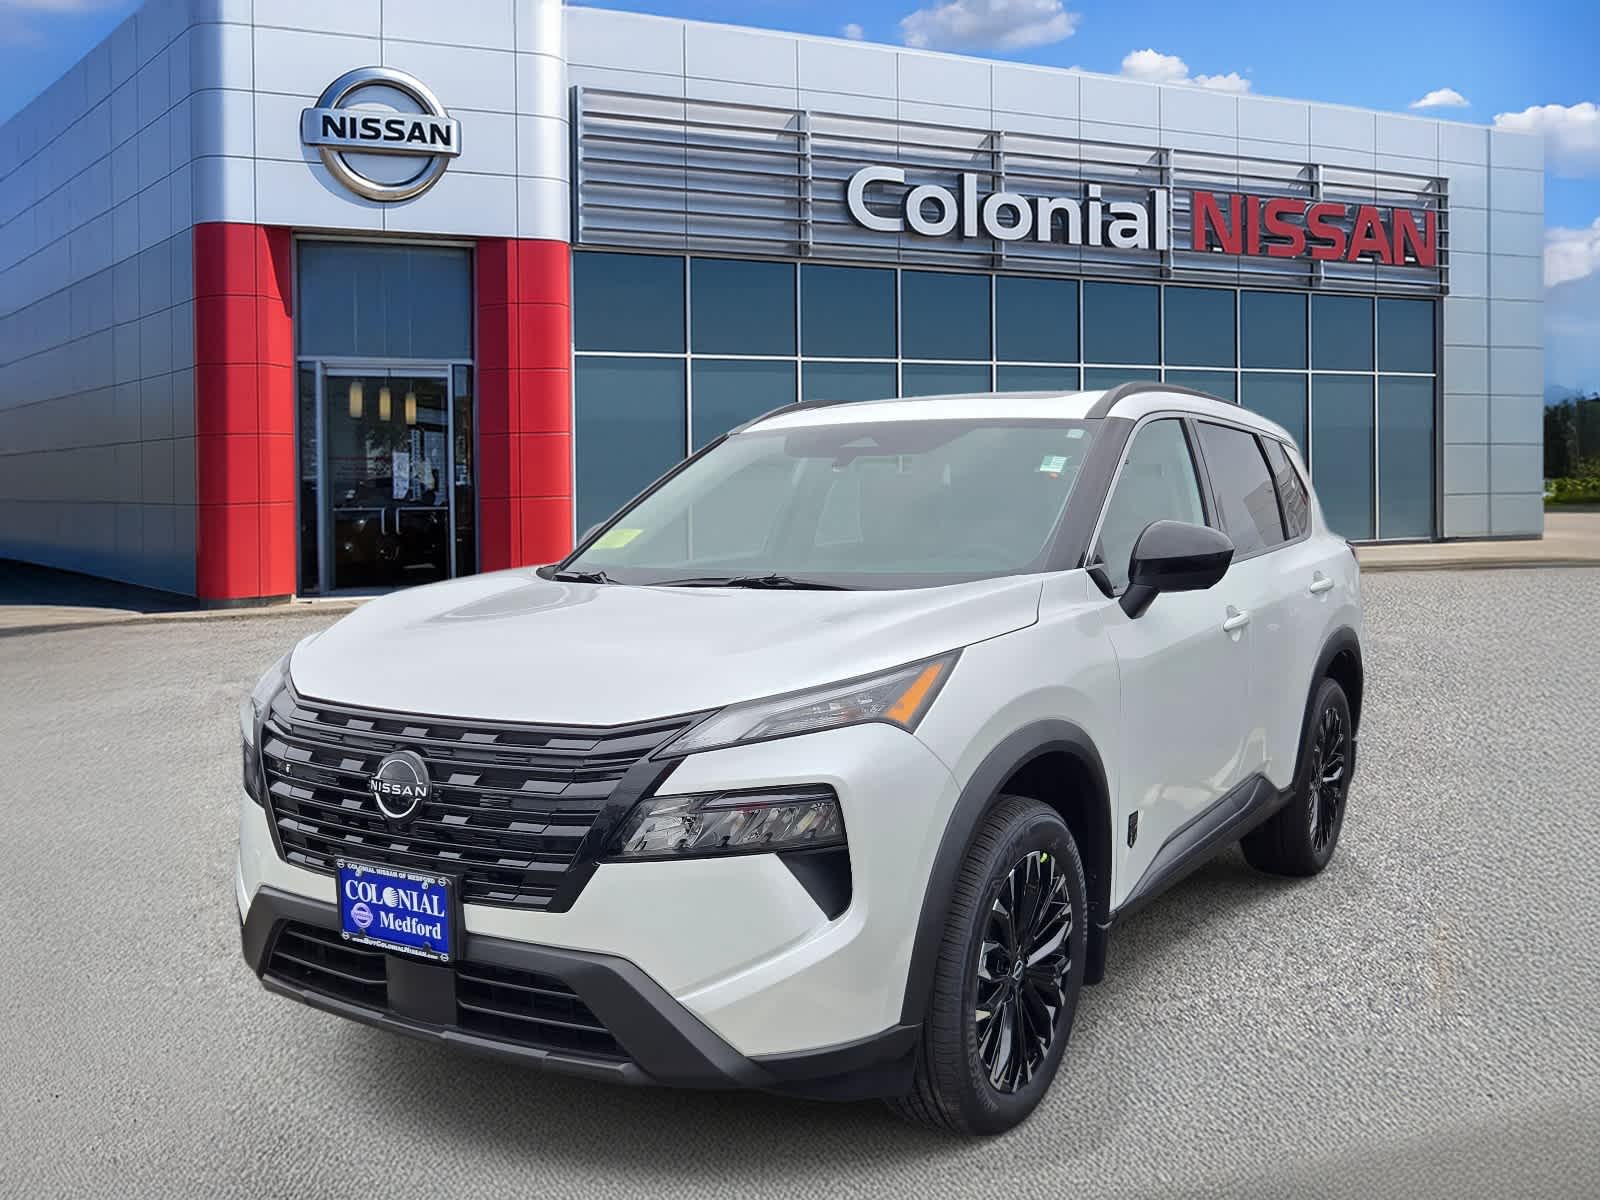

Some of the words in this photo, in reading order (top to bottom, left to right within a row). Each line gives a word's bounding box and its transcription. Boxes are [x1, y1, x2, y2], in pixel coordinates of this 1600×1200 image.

[322, 115, 451, 146] NISSAN
[847, 166, 1167, 250] Colonial
[1191, 191, 1435, 266] NISSAN
[370, 779, 427, 797] NISSAN
[345, 880, 445, 917] COLONIAL
[379, 911, 441, 939] Medford
